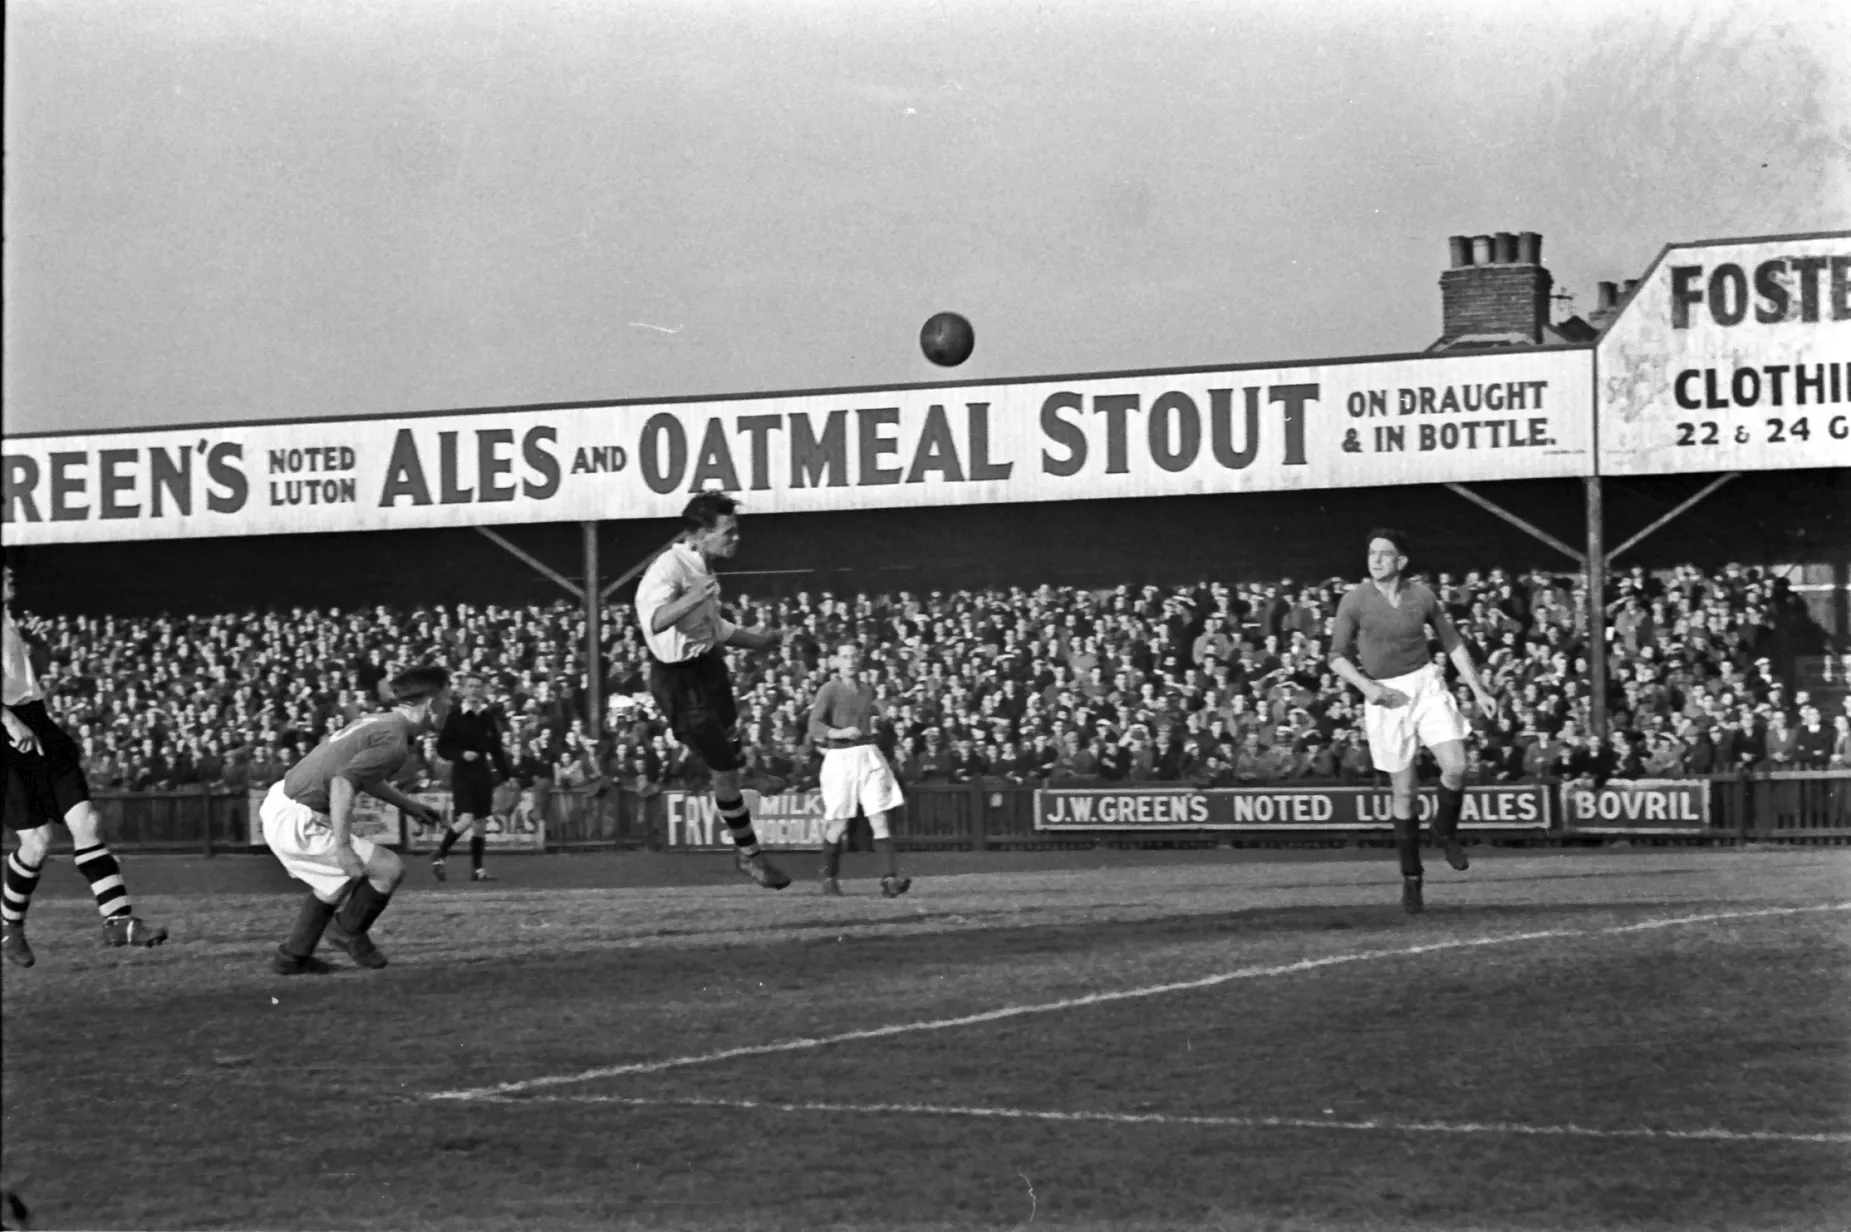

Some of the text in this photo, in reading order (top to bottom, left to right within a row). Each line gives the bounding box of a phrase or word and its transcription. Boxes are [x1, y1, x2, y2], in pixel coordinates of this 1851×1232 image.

[1347, 380, 1548, 417] ON DRAUGHT
[1674, 362, 1851, 409] CLOTHI
[378, 383, 1320, 508] ALES AND OATMEAL STOUT
[1341, 417, 1557, 453] & IN BOTTLE.
[1676, 421, 1719, 446] 22
[1734, 425, 1750, 444] &
[1766, 417, 1810, 443] 24
[267, 445, 356, 474] NOTED
[3, 438, 249, 523] REEN'S
[269, 478, 356, 506] LUTON
[1234, 795, 1333, 821] NOTED
[1460, 793, 1537, 821] ALES
[1575, 790, 1699, 821] BOVRIL
